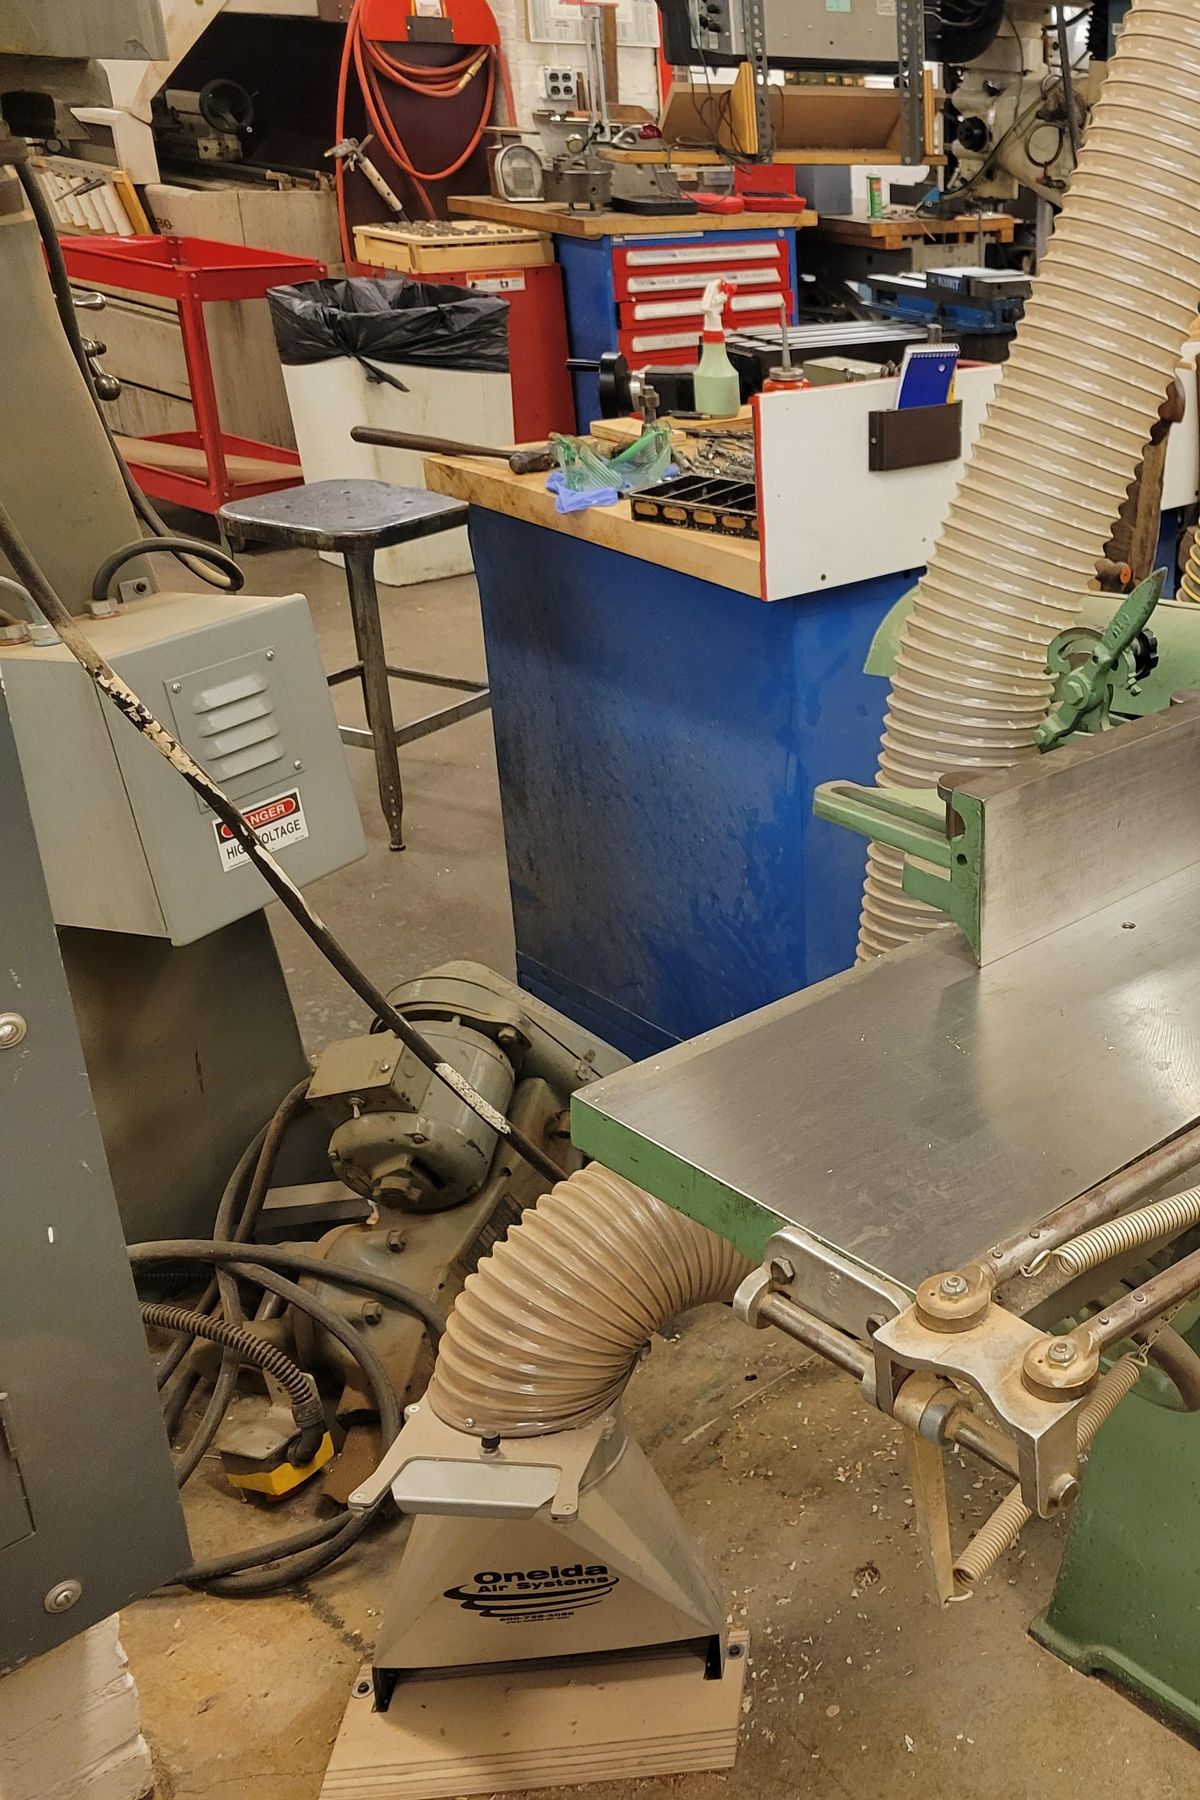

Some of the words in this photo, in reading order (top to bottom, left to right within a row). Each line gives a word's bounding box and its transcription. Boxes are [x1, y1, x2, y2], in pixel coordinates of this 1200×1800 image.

[226, 841, 246, 860] HIG
[258, 819, 302, 845] OLTAGE
[473, 1563, 609, 1585] Oneida
[477, 1584, 508, 1593] Air
[516, 1577, 609, 1591] Systems
